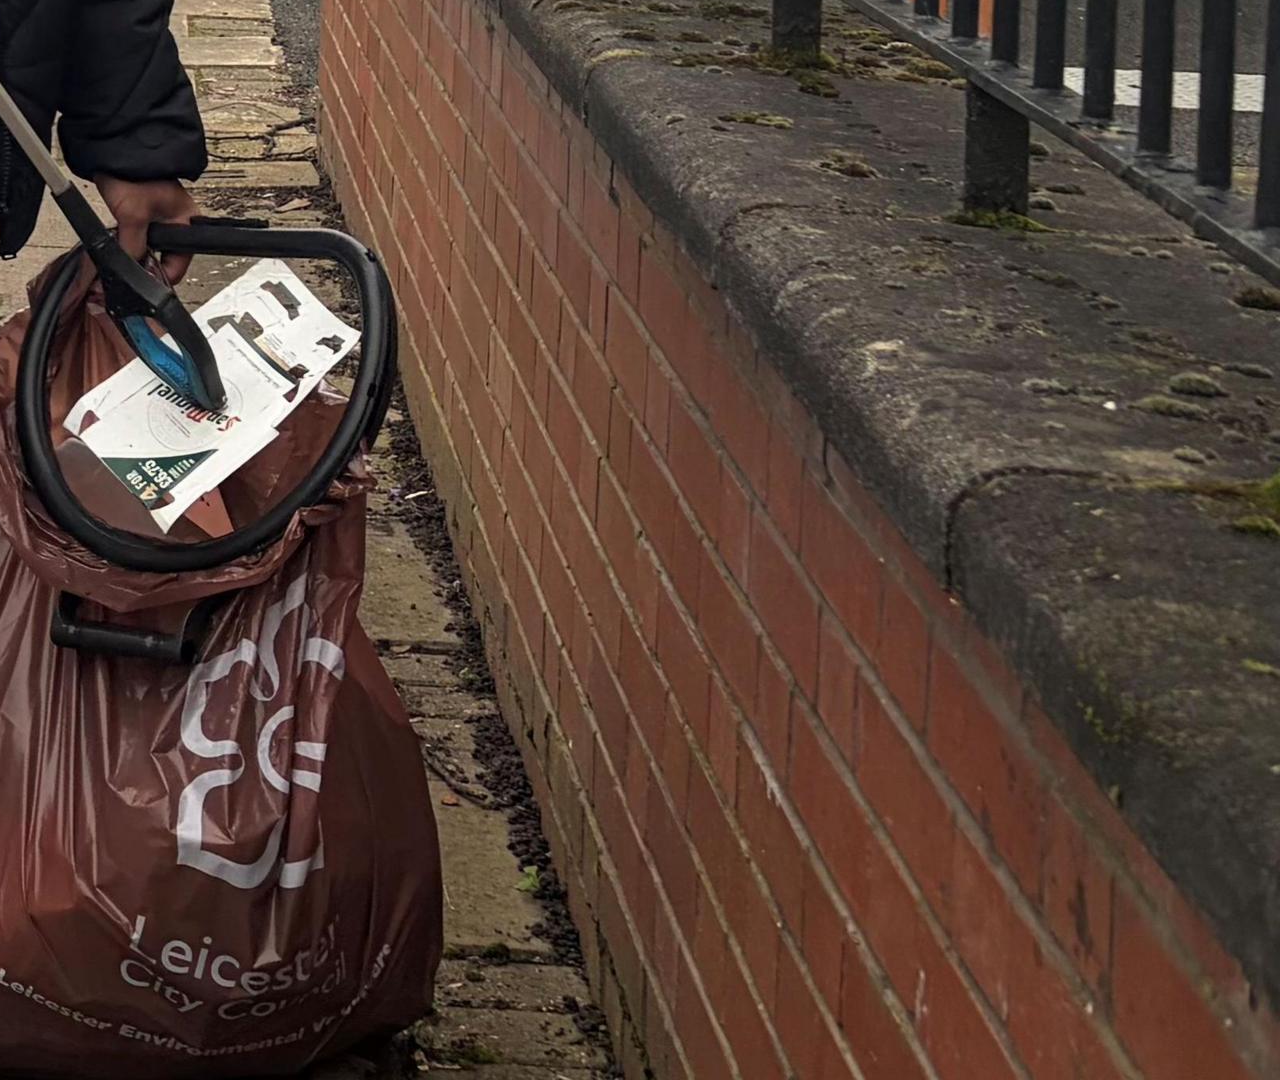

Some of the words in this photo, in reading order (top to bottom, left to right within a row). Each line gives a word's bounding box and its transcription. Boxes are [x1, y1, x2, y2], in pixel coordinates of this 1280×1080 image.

[126, 470, 148, 487] FOR
[139, 482, 158, 502] 4
[119, 958, 204, 1012] City
